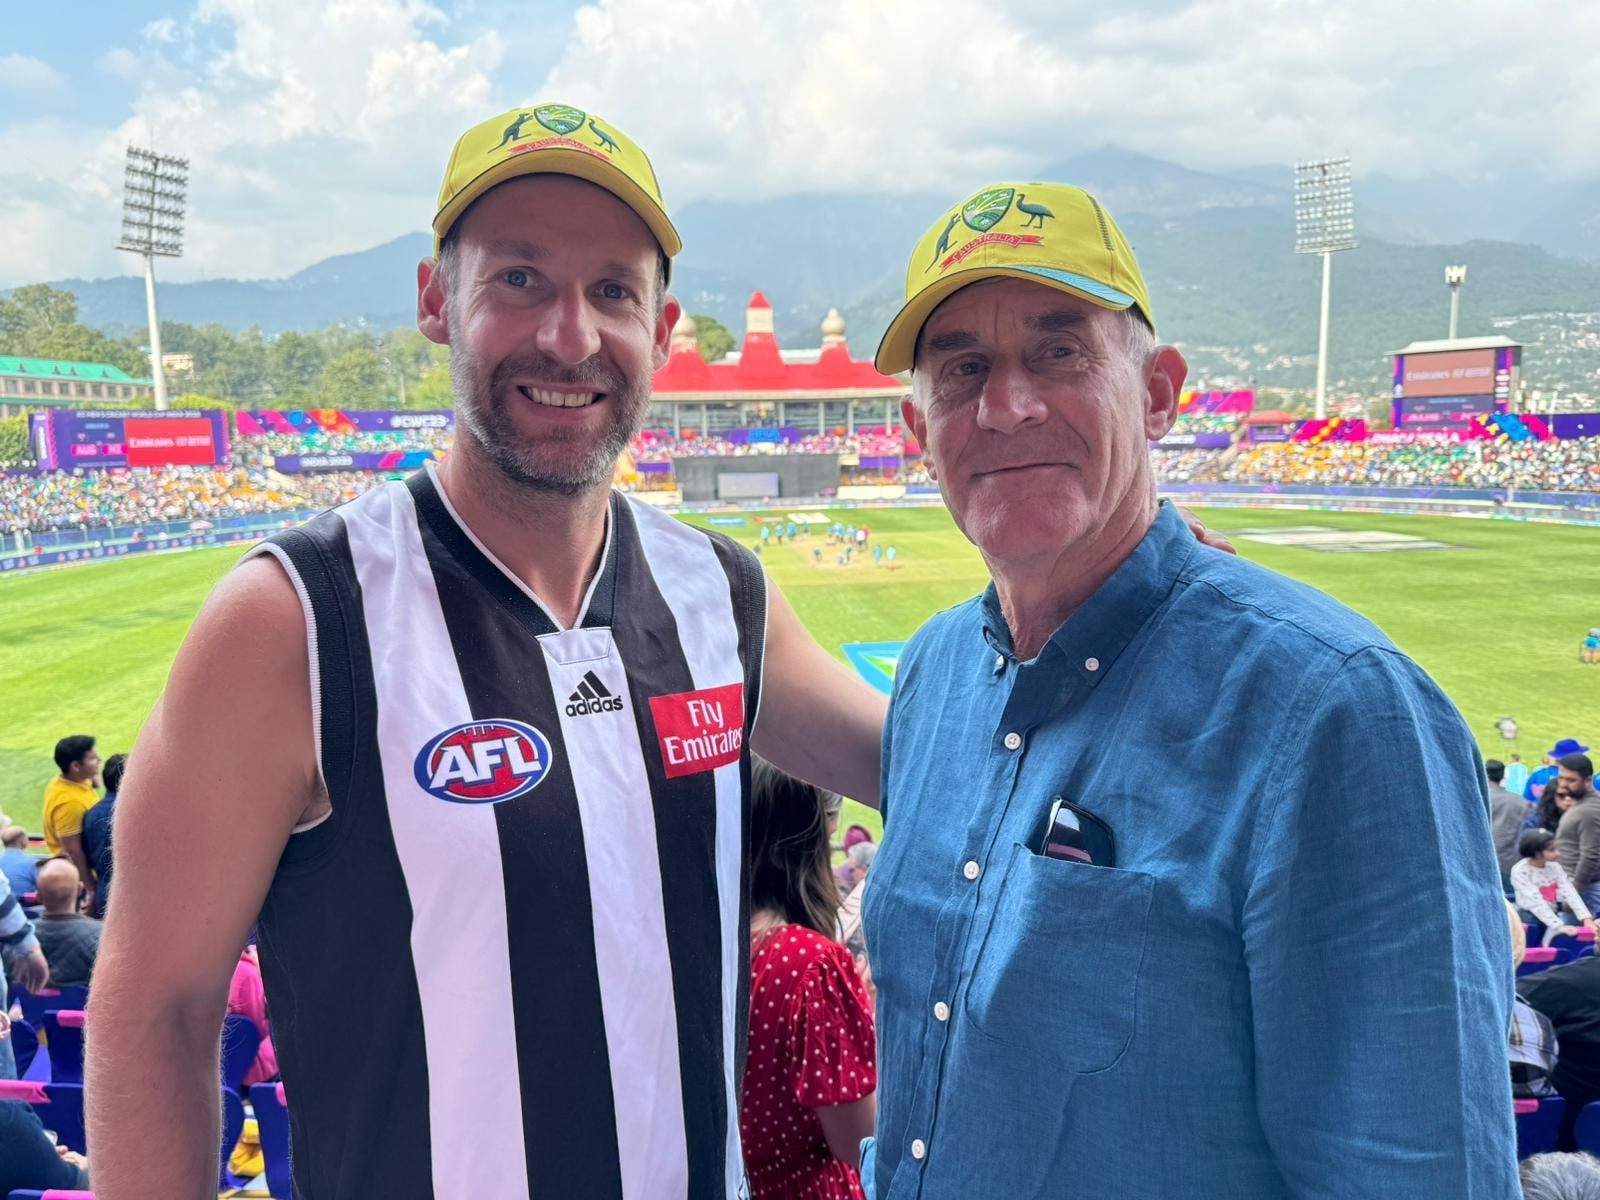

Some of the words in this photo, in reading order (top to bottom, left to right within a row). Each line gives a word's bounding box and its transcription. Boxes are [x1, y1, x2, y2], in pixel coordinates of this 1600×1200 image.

[959, 234, 1015, 255] AUSTRALIA
[565, 695, 623, 717] adidas
[686, 699, 724, 728] Fly
[664, 727, 742, 765] Emirates
[429, 735, 542, 789] AFL
